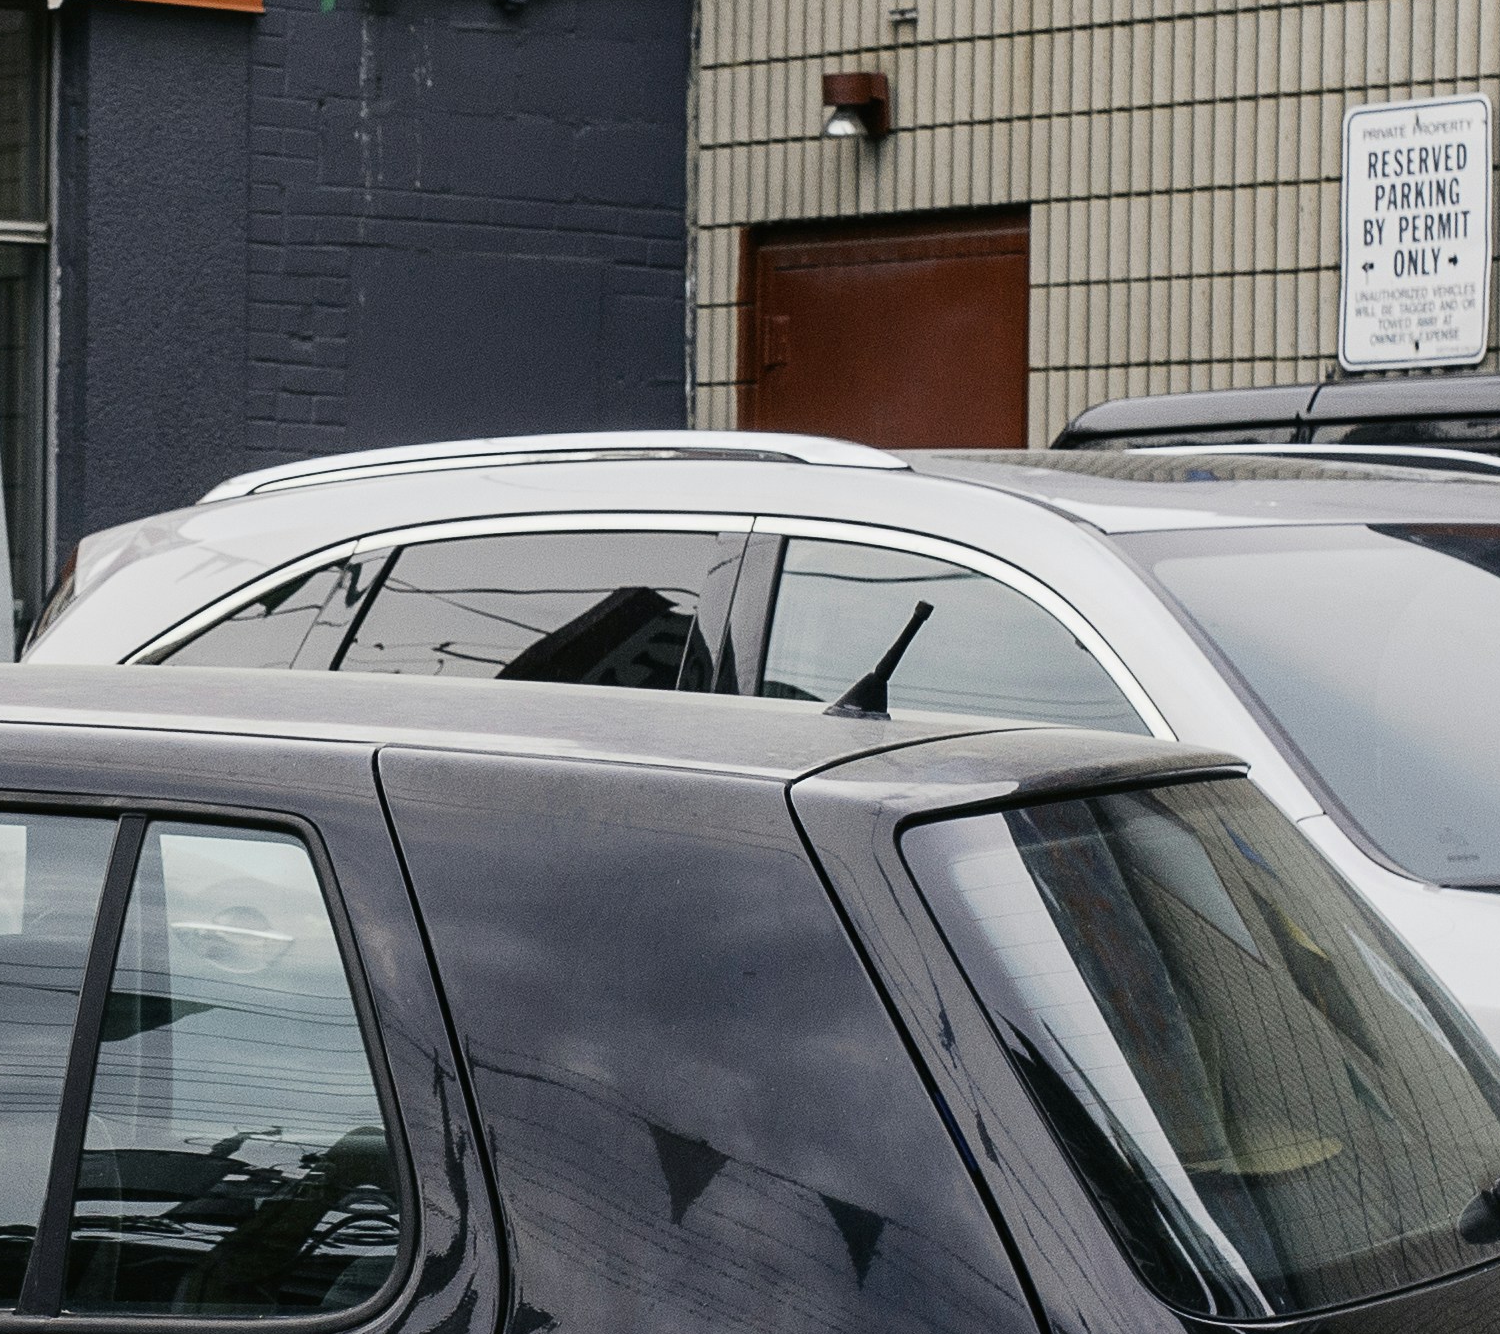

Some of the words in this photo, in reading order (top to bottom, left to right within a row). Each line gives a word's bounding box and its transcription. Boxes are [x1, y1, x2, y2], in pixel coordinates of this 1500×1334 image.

[1368, 142, 1467, 180] RESERVED
[1375, 178, 1460, 212] PARKING
[1363, 218, 1386, 246] BY
[1398, 210, 1471, 243] PERMIT
[1393, 247, 1441, 278] ONLY
